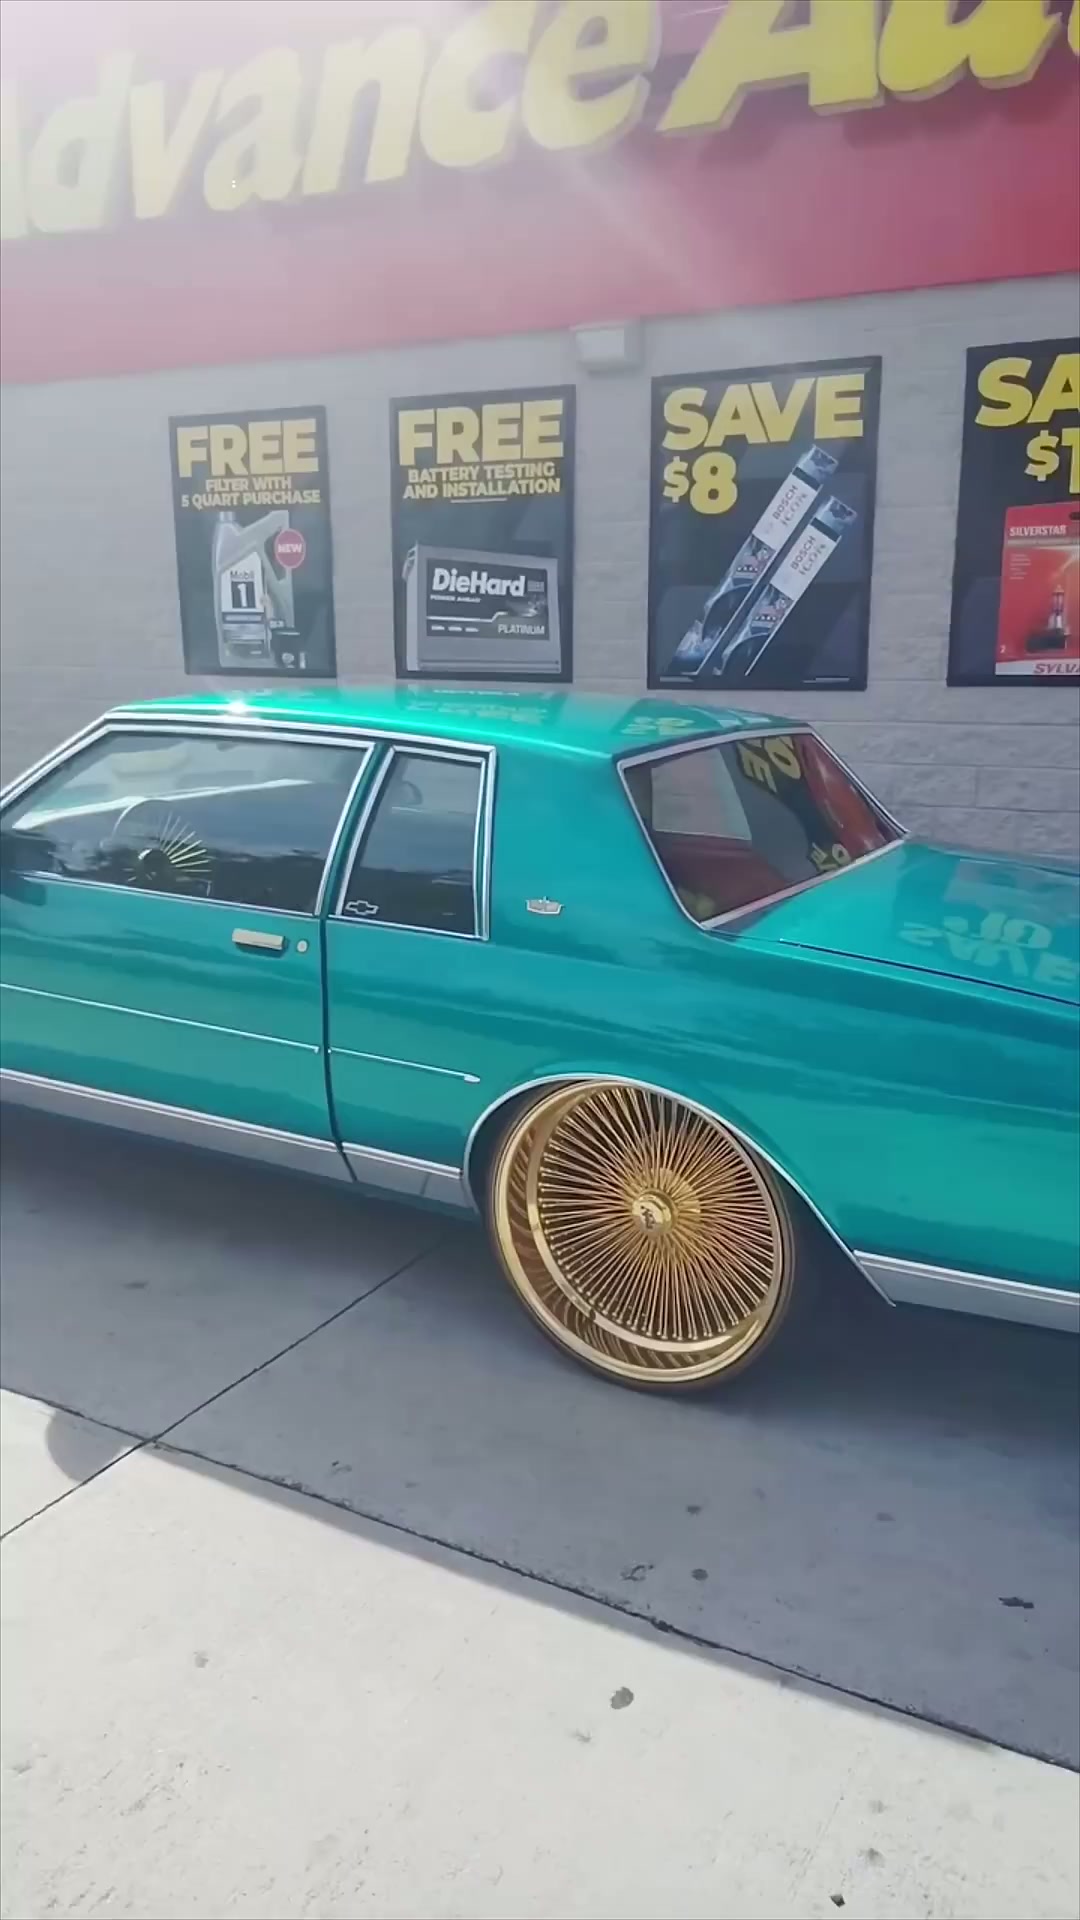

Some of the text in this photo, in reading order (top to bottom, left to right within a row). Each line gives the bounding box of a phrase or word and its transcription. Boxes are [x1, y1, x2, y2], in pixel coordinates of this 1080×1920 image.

[0, 0, 1080, 240] dvance Au
[662, 374, 865, 450] SAVE
[398, 400, 564, 466] FREE
[176, 418, 319, 477] FREE
[205, 475, 292, 492] FILTER WITH
[408, 461, 555, 483] BATTERY TESTING
[663, 451, 738, 514] $8
[181, 489, 320, 511] 5 QUART PURCHASE
[403, 478, 561, 499] AND INSTALLATION
[772, 484, 798, 520] BOSCH
[1009, 525, 1067, 537] SILVERSTAR
[277, 543, 303, 553] NEW
[790, 535, 816, 570] BOSCH
[237, 583, 248, 607] 1
[432, 567, 526, 597] DieHard
[497, 624, 544, 634] PLATINUM
